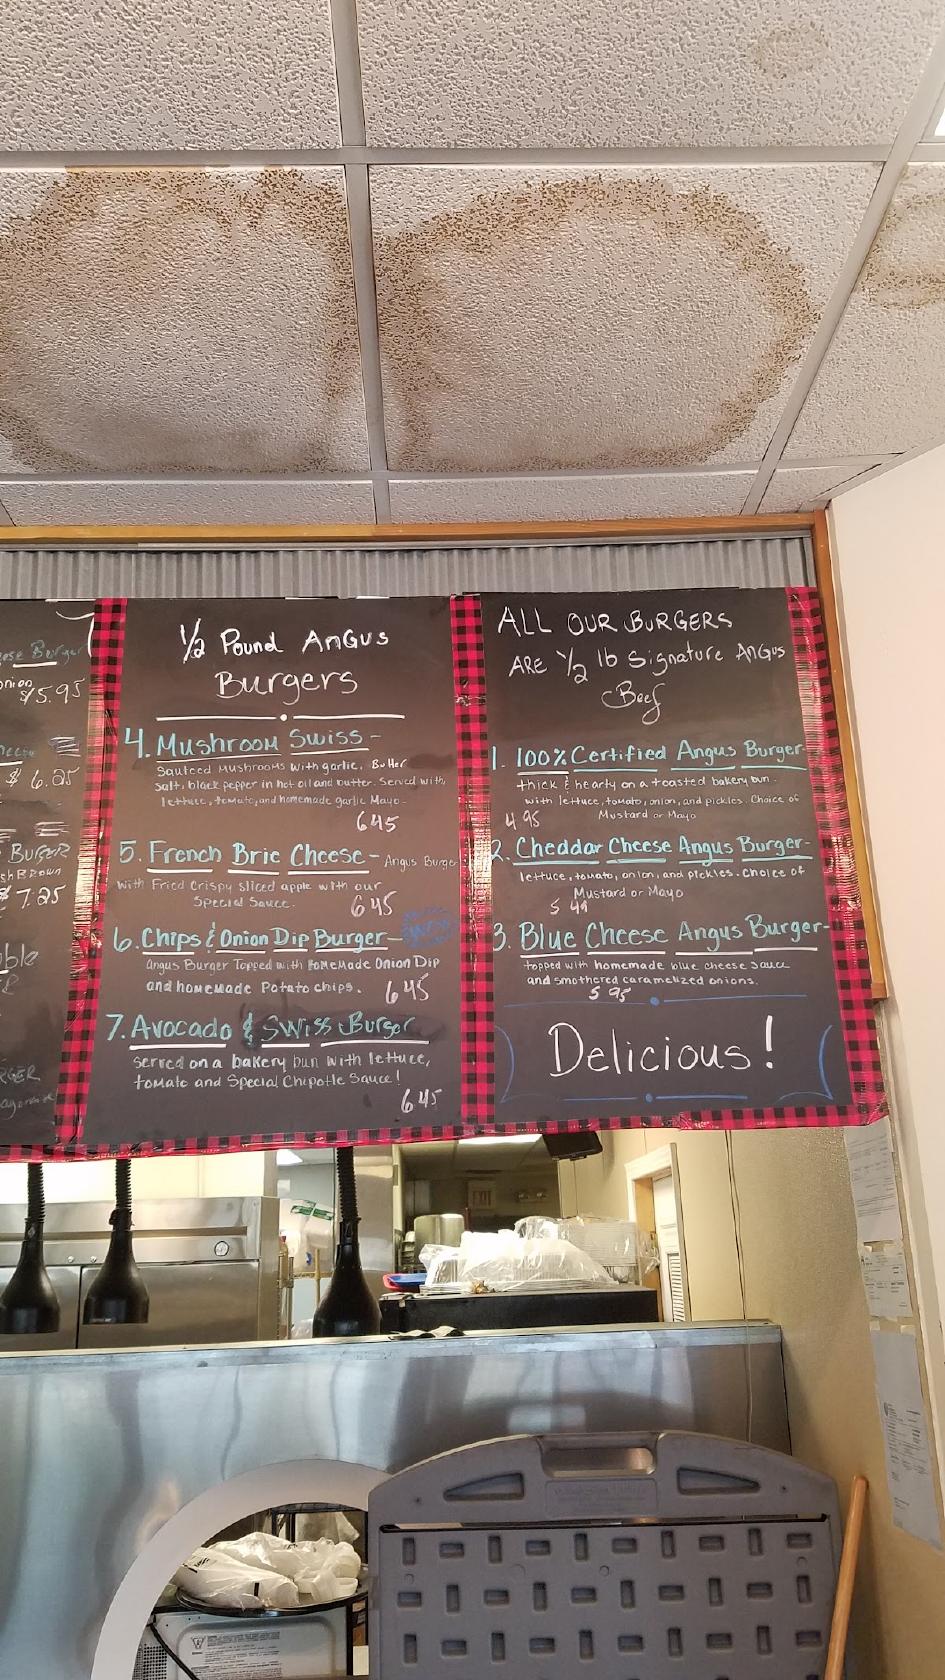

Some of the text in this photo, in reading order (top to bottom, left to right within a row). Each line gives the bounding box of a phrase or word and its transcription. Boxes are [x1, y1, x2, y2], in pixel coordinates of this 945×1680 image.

[498, 606, 552, 637] ALL
[567, 612, 617, 635] OUR
[220, 628, 284, 656] Pound
[509, 655, 547, 678] ARE
[628, 640, 724, 676] Signature
[214, 671, 358, 705] Burgers
[601, 681, 666, 725] Beef
[125, 728, 150, 758] 4.
[517, 747, 567, 768] 100%
[571, 745, 666, 765] Certified
[676, 739, 736, 765] Angus
[188, 780, 220, 790] black
[223, 781, 259, 792] pepper
[261, 780, 273, 789] in
[277, 780, 295, 789] hot
[298, 779, 311, 788] oil
[314, 778, 333, 787] and
[516, 779, 557, 791] thick
[575, 779, 616, 790] hearty
[621, 781, 635, 789] on
[651, 776, 705, 788] toasted
[712, 776, 748, 787] bakery
[260, 795, 276, 805] and
[280, 794, 331, 805] homemade
[336, 795, 366, 808] garlic
[525, 796, 552, 806] with
[682, 796, 701, 806] and
[751, 794, 784, 804] Choice
[788, 793, 799, 803] of
[598, 810, 648, 820] Mustard
[668, 810, 696, 821] Mayo
[149, 841, 222, 865] French
[232, 843, 280, 865] Brie
[384, 855, 417, 872] Angus
[424, 855, 457, 870] Burge
[516, 836, 602, 858] Cheddar
[608, 837, 672, 857] Cheese
[679, 835, 733, 866] Angus
[663, 869, 683, 879] and
[791, 865, 805, 877] of
[117, 878, 144, 890] with
[152, 878, 185, 891] Fried
[239, 880, 275, 892] sliced
[281, 882, 312, 893] apple
[319, 881, 348, 891] with
[355, 882, 381, 891] our
[574, 885, 684, 902] Mustard or Mayo
[194, 896, 243, 908] Special
[142, 927, 201, 952] Chips
[220, 928, 269, 947] Onion
[273, 927, 310, 950] Dip
[519, 922, 577, 951] Blue
[586, 922, 669, 945] Cheese
[678, 920, 743, 952] Angus
[0, 943, 39, 969] ble
[184, 959, 229, 976] Burger
[276, 959, 302, 970] with
[375, 957, 411, 969] Onion
[413, 955, 440, 969] Dip
[524, 960, 561, 972] topped
[565, 961, 588, 970] with
[594, 960, 665, 970] homemade
[671, 961, 699, 970] blue
[704, 961, 747, 970] cheese
[146, 980, 172, 992] and
[177, 980, 252, 994] homemade
[527, 975, 551, 986] and
[554, 975, 618, 986] smothered
[623, 975, 704, 986] caramelized
[131, 1014, 232, 1040] Avocado
[262, 1014, 332, 1042] Swiss
[338, 1011, 415, 1036] Burger
[133, 1056, 184, 1070] served
[189, 1058, 208, 1069] on
[212, 1059, 223, 1069] a
[232, 1053, 286, 1073] bakery
[293, 1054, 319, 1068] bun
[327, 1052, 362, 1067] with
[134, 1074, 188, 1090] tomato
[194, 1077, 221, 1088] and
[228, 1074, 279, 1090] Special
[283, 1074, 345, 1089] Chipotle
